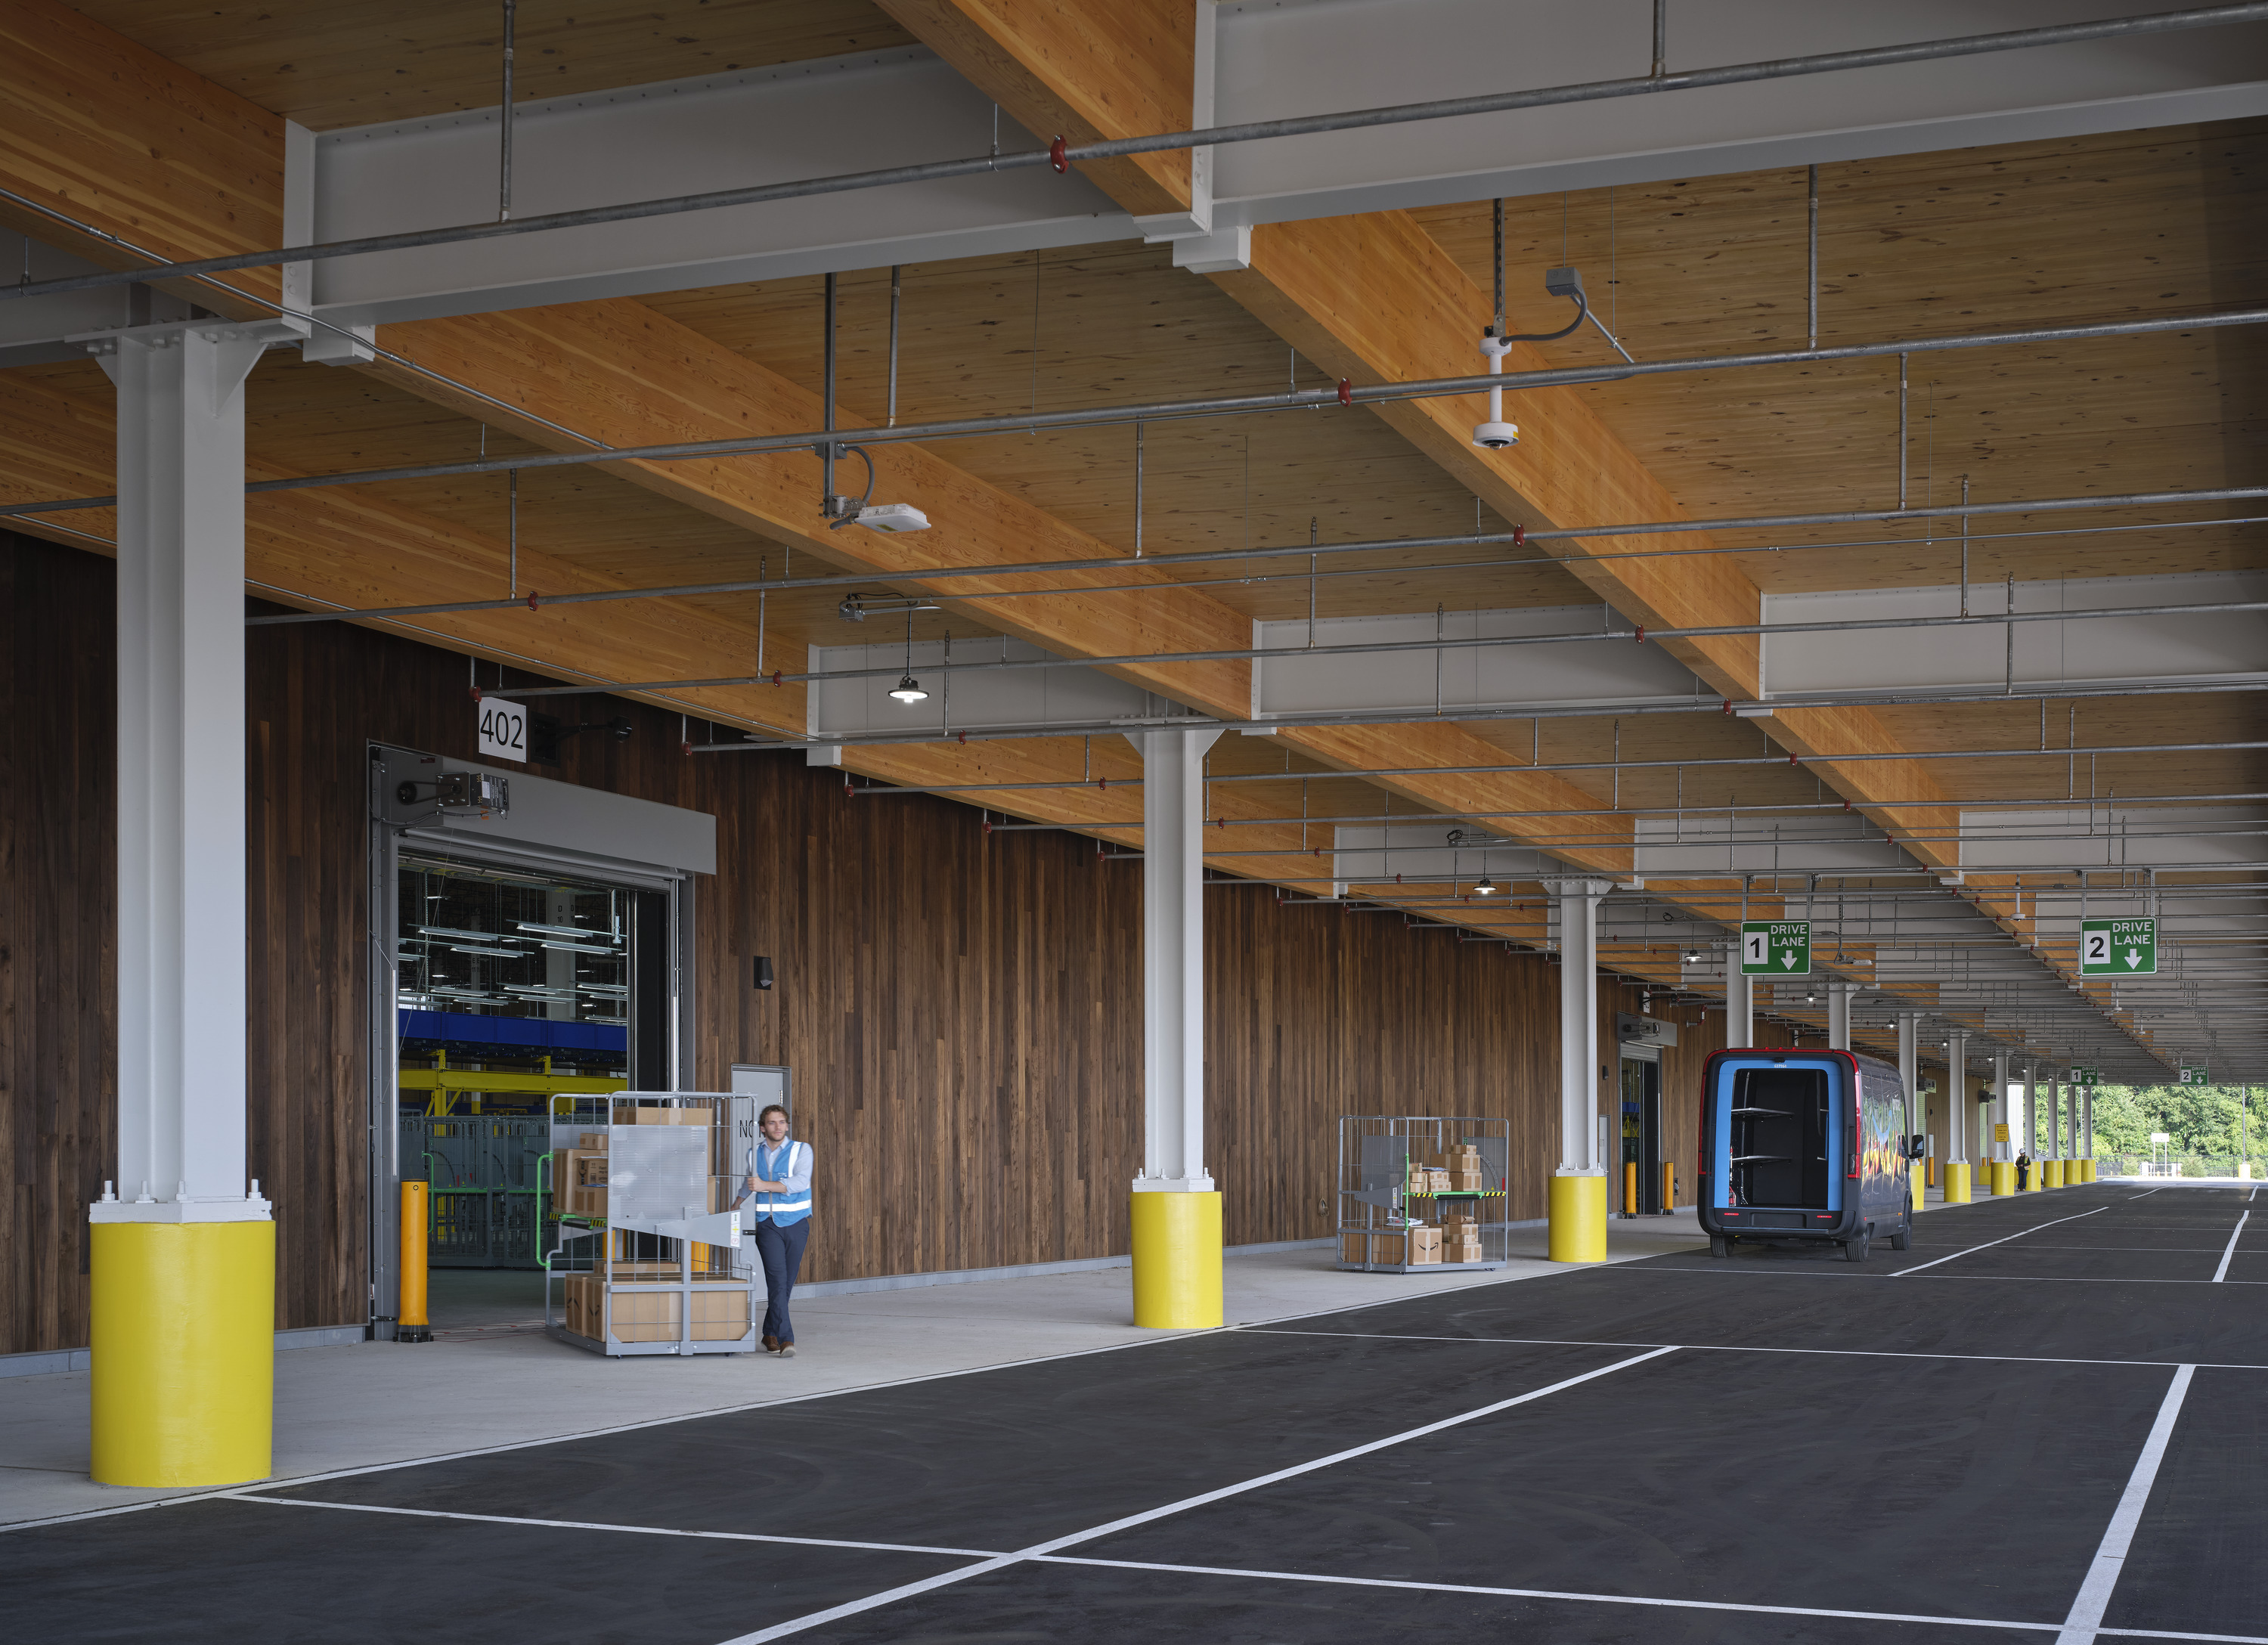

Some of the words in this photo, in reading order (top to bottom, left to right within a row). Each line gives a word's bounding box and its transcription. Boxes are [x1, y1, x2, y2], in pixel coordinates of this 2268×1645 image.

[480, 709, 523, 750] 402
[1771, 925, 1808, 934] DRIVE
[2112, 922, 2152, 933] DRIVE
[1772, 937, 1805, 946] LANE
[2115, 934, 2151, 945] LANE
[1750, 937, 1760, 959] 1
[2089, 936, 2105, 958] 2
[2074, 1071, 2078, 1080] 1
[2183, 1071, 2189, 1080] 2
